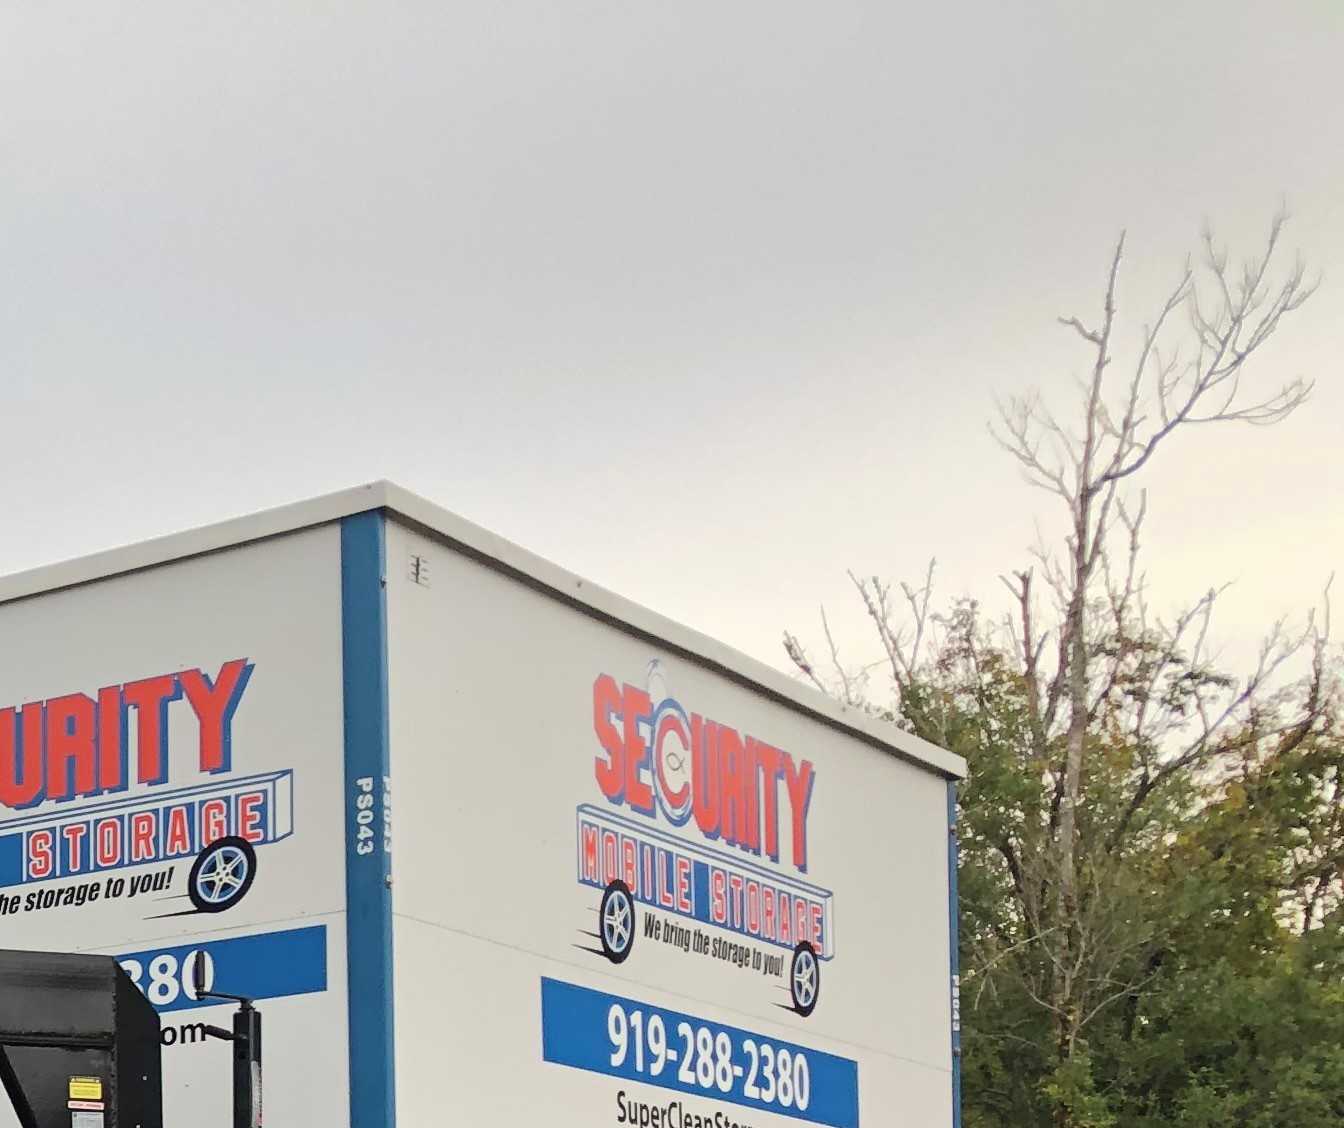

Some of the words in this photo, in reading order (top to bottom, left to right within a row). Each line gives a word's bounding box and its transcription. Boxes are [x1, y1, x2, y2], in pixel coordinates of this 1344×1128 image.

[593, 672, 815, 873] SECURITY
[29, 793, 264, 878] STORAGE
[356, 776, 375, 856] PS043
[24, 880, 101, 912] storage
[104, 878, 125, 899] to
[128, 866, 175, 897] you!
[582, 823, 691, 913] MOBILE
[713, 869, 822, 955] STORAGE
[644, 911, 661, 941] We
[662, 918, 691, 953] bring
[692, 928, 710, 956] the
[711, 936, 751, 968] storage
[752, 947, 762, 971] to
[763, 953, 785, 978] you!
[607, 1003, 810, 1111] 919-288-2380
